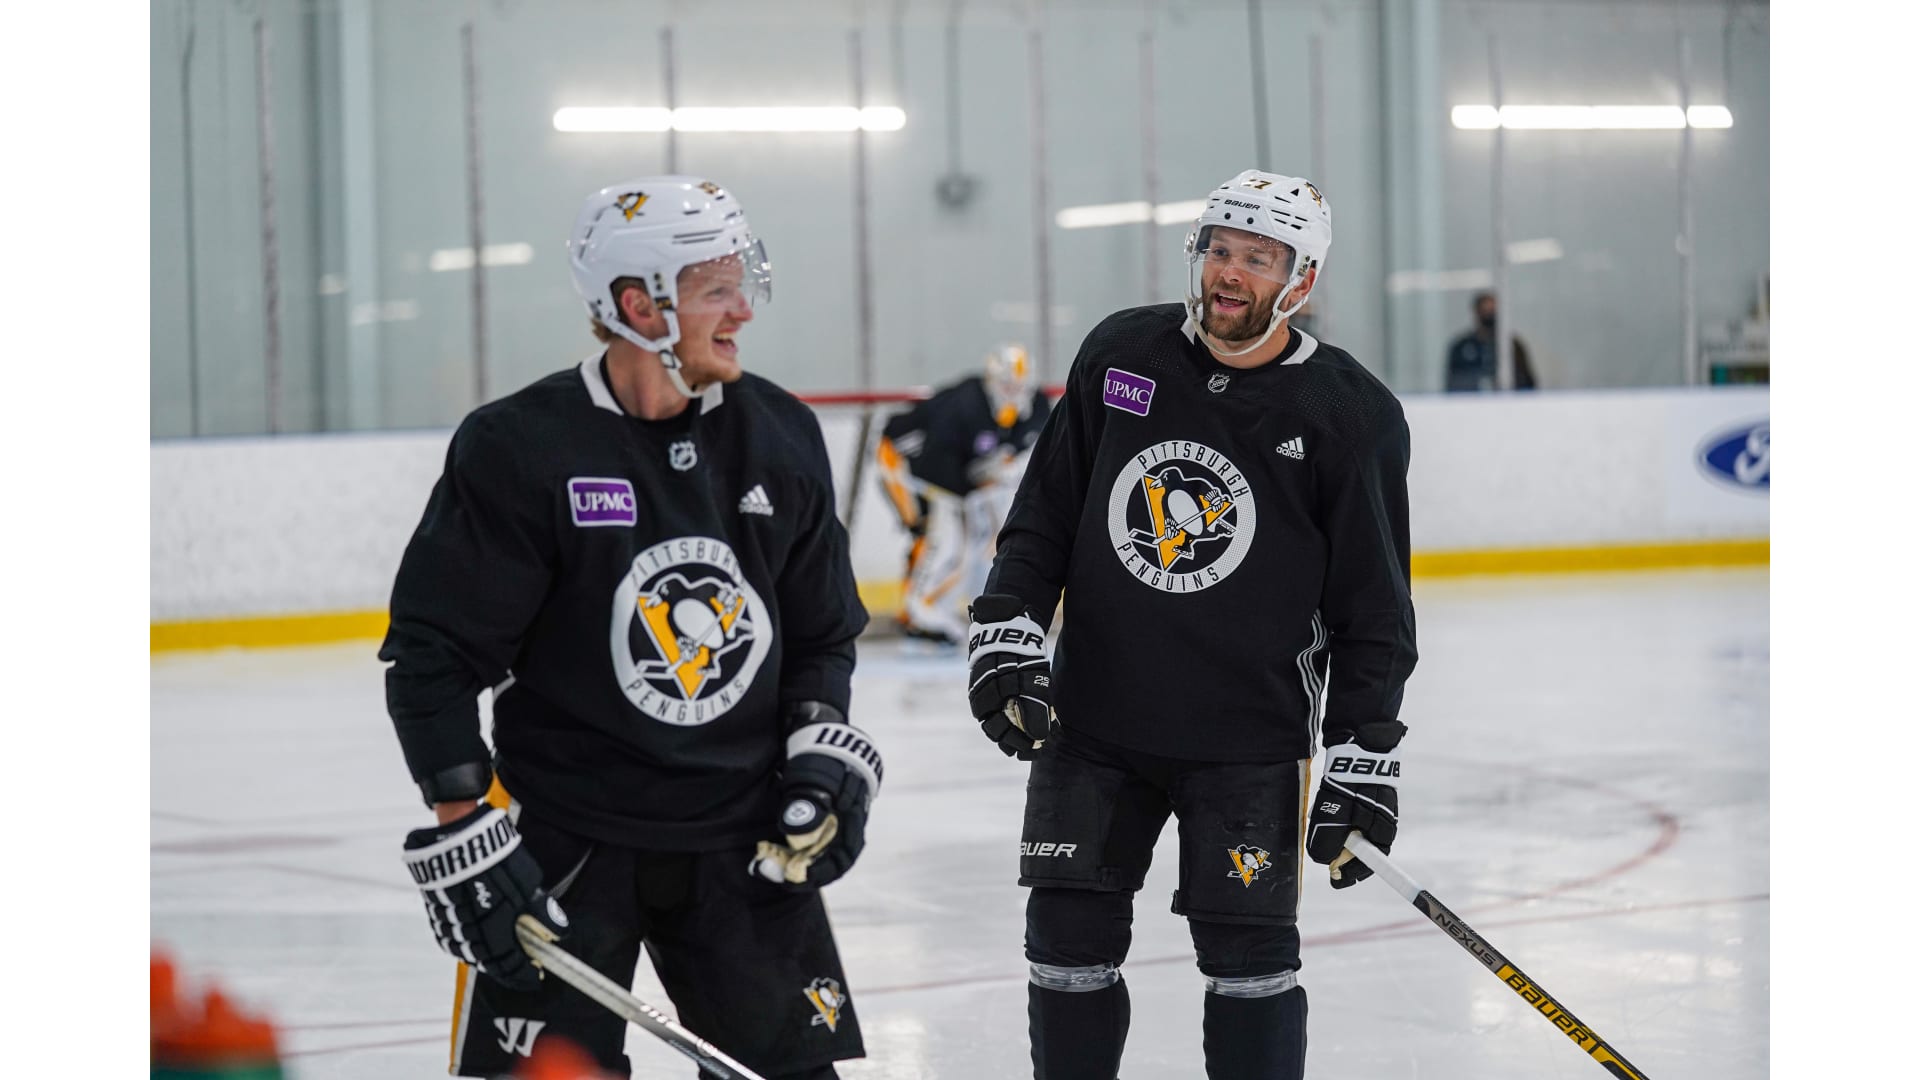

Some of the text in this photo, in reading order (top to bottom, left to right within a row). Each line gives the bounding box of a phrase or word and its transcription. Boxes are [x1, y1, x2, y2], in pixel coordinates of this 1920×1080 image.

[1223, 199, 1261, 212] BAUER
[1105, 378, 1151, 405] UPMC
[1137, 441, 1249, 498] PITTSBURGH
[1276, 446, 1305, 460] adidas
[574, 491, 635, 513] UPMC
[1117, 541, 1220, 592] PENGUINS
[968, 628, 1044, 661] AUER
[626, 680, 744, 722] PENGUINS
[1435, 911, 1497, 967] NEXUS
[1505, 972, 1589, 1047] BAUER
